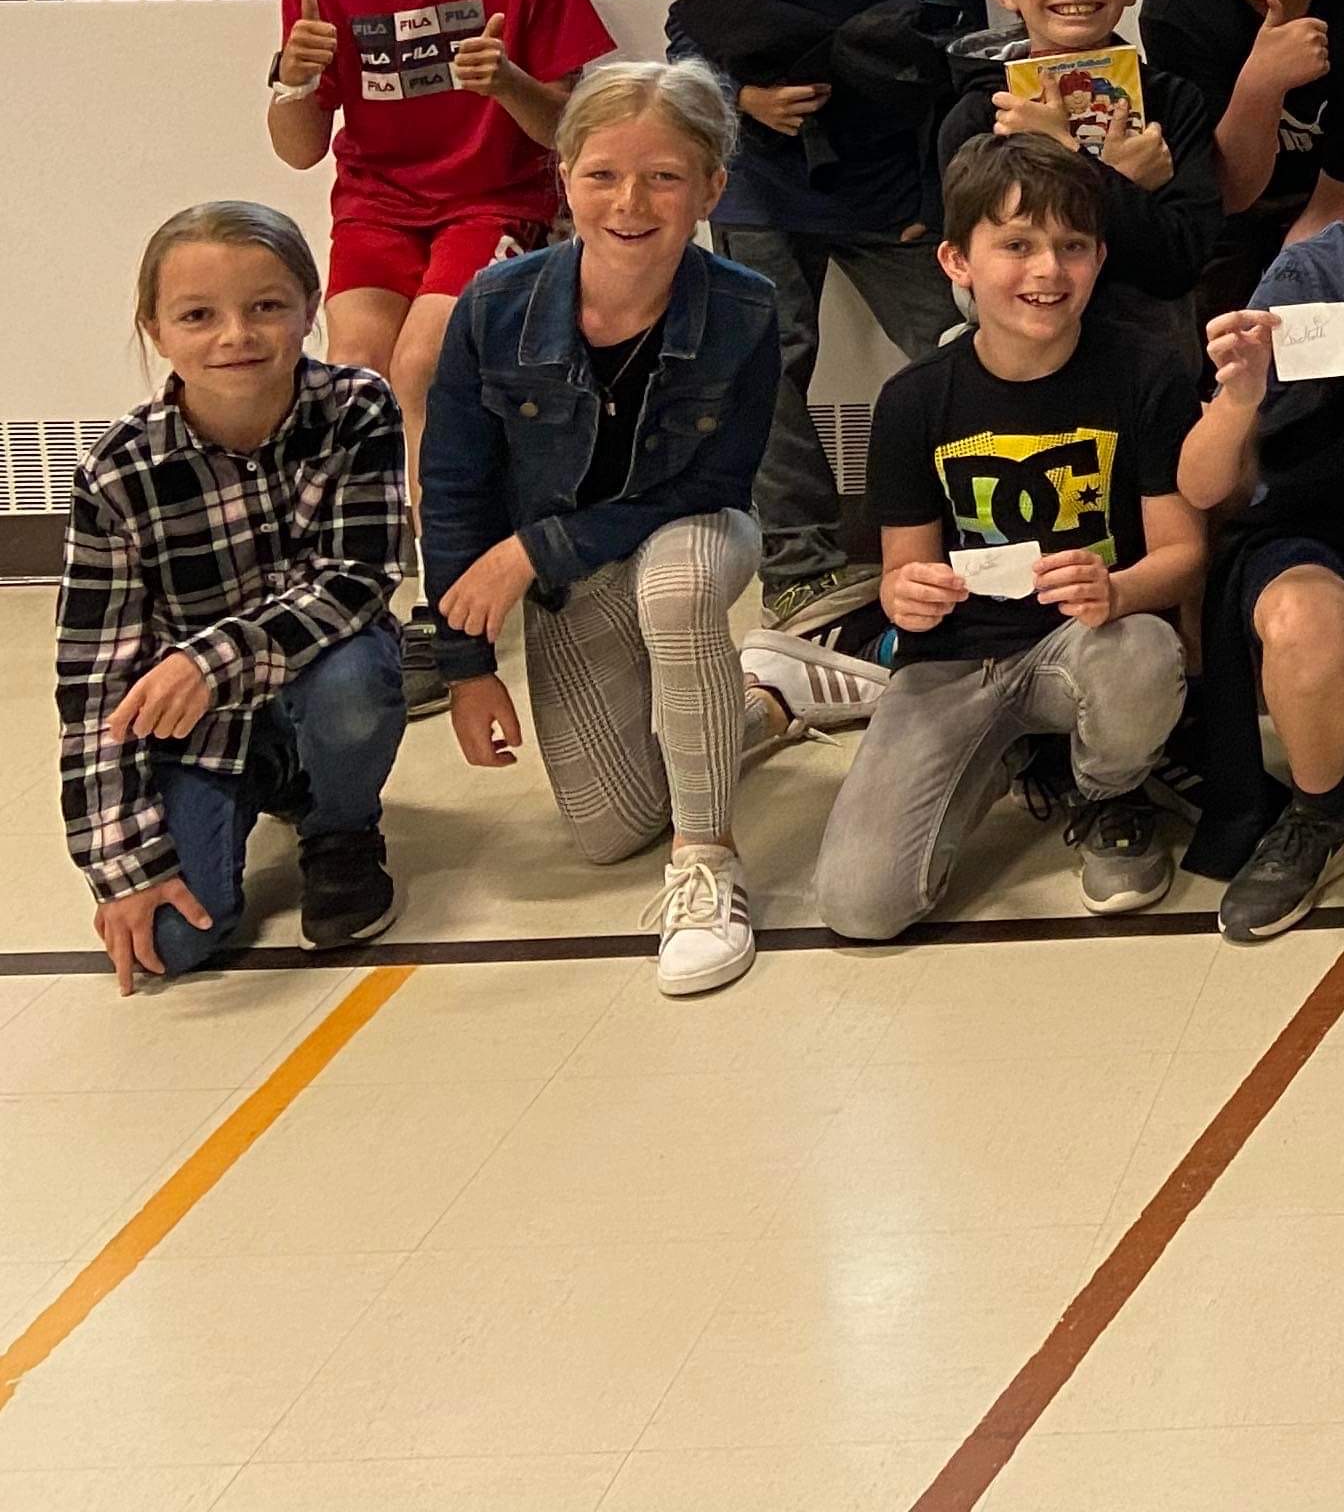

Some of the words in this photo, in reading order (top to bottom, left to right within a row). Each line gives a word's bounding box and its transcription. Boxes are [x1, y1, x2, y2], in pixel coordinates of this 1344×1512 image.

[353, 23, 388, 36] FILA
[400, 18, 432, 32] FILA
[445, 7, 479, 22] FILA
[367, 80, 395, 93] FILA
[408, 73, 444, 89] FILA
